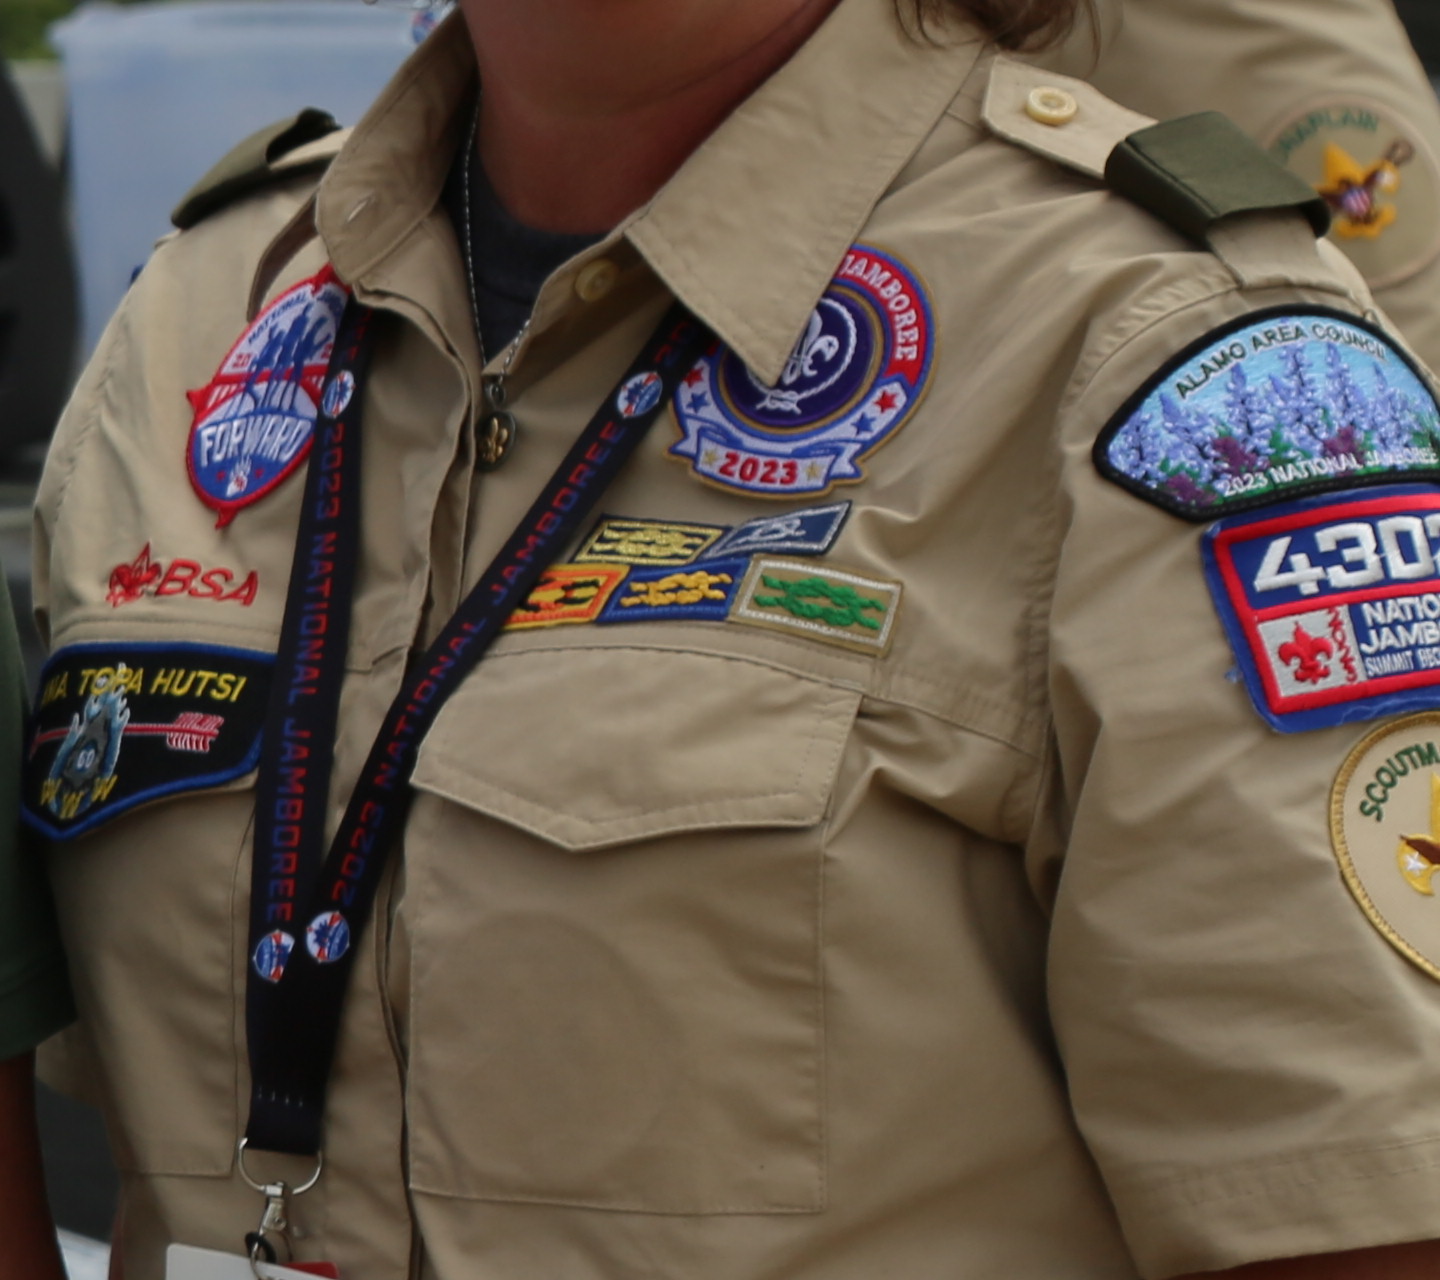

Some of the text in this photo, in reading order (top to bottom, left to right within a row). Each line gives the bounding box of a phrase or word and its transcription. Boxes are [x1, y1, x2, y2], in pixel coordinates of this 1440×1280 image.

[247, 291, 308, 344] NATIONAL
[839, 253, 920, 361] JAMBOREE
[1174, 323, 1388, 400] ALAMO AREA COUNCIL
[200, 415, 313, 468] FORWARD
[719, 451, 799, 484] 2023
[1222, 474, 1269, 498] 2023
[1271, 452, 1361, 485] NATIONAL
[154, 558, 259, 608] BSA
[1361, 593, 1440, 627] NATIO
[1360, 621, 1440, 656] JAMB
[1365, 650, 1416, 678] SUMMIT
[79, 666, 142, 696] TOPA
[151, 668, 248, 702] HUTSI
[266, 423, 344, 922] 2023 NATIONAL JAMBOREE
[332, 422, 628, 907] 2023 NATIONAL JAMBOREE
[1359, 741, 1440, 823] SCOUTM
